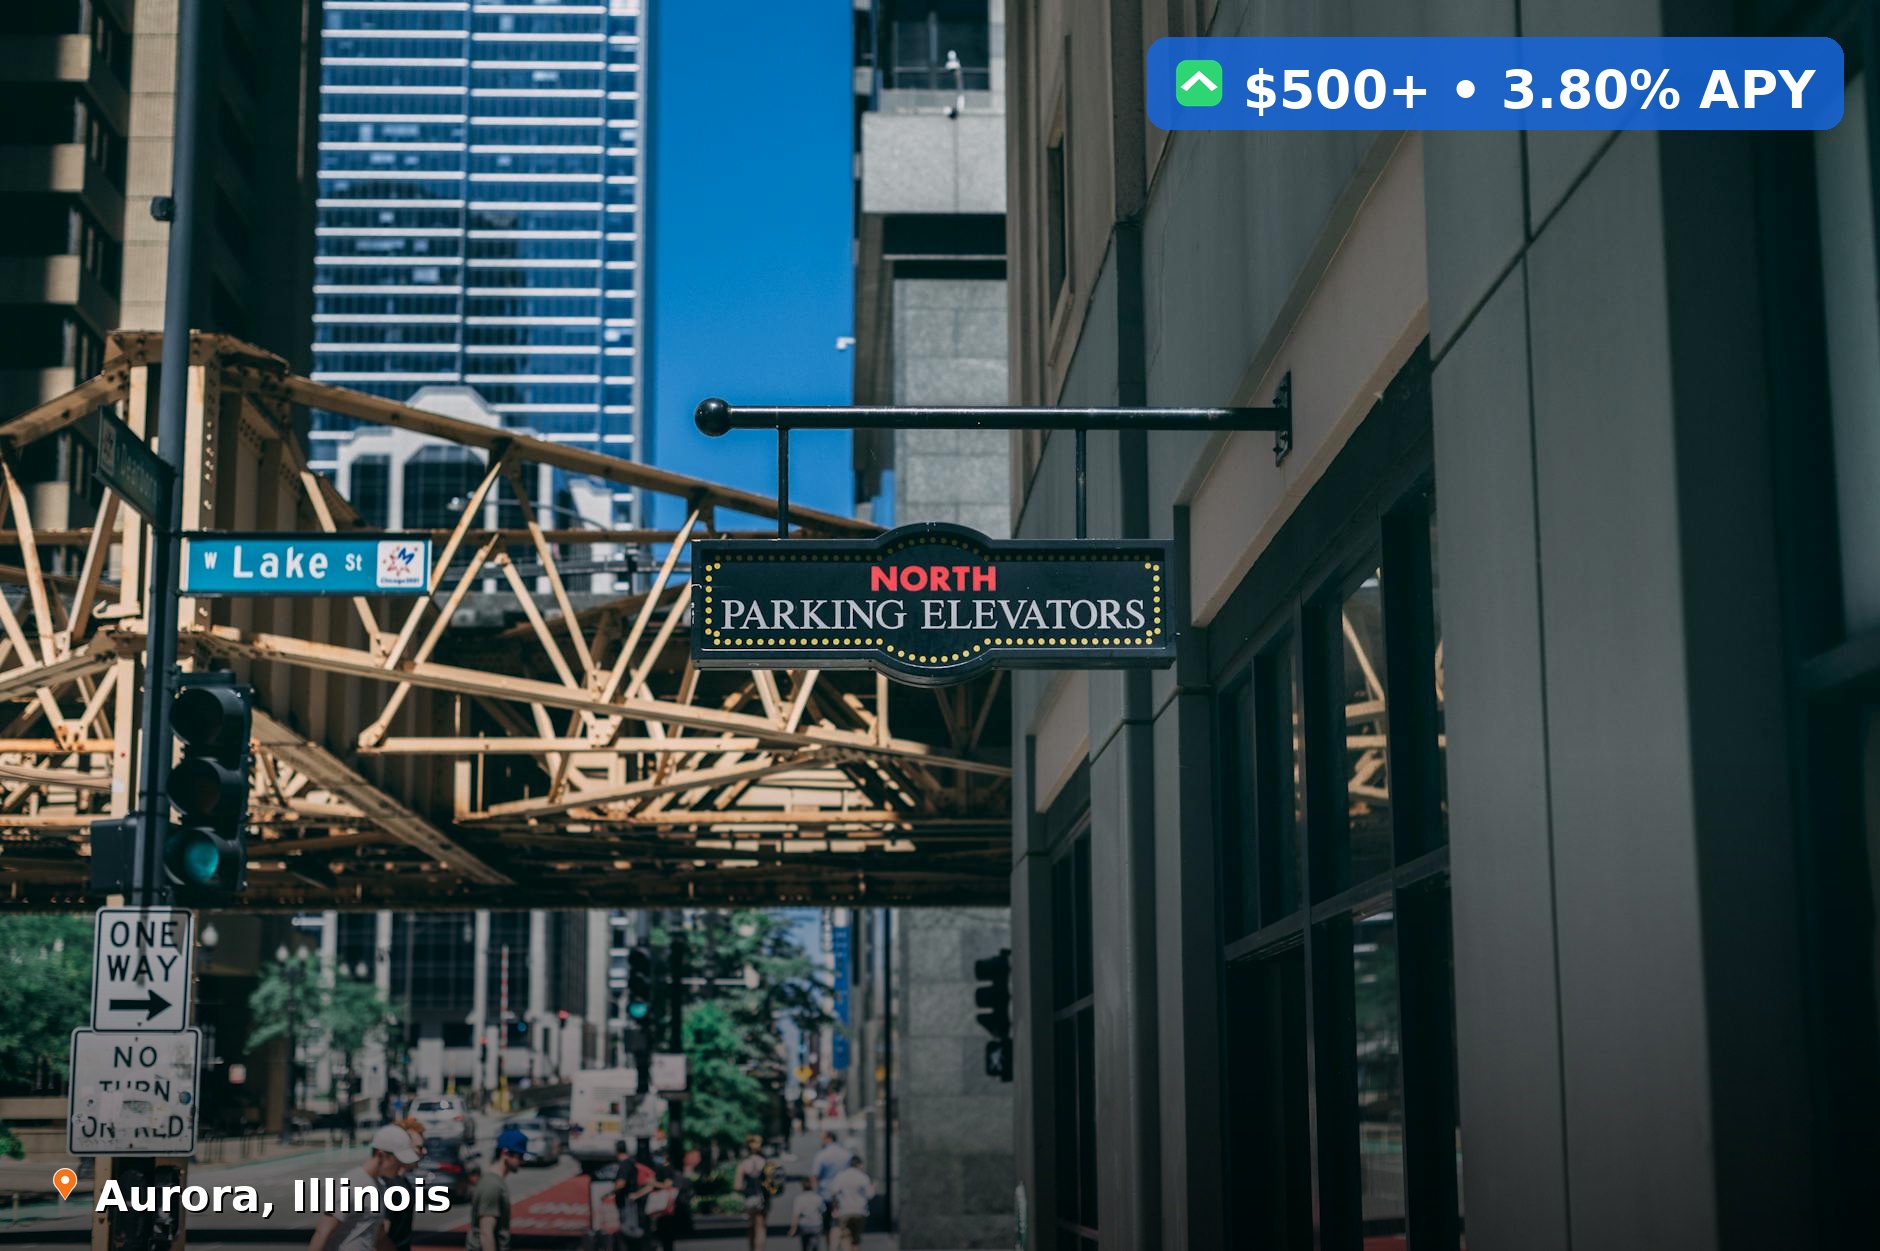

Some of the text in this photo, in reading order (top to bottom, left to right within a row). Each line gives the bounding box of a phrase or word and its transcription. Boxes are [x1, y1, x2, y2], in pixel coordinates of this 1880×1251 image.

[204, 545, 363, 579] W Lake St
[871, 565, 997, 592] NORTH
[720, 599, 1146, 630] PARKING ELEVATORS
[111, 921, 178, 948] ONE
[107, 954, 178, 982] WAY
[114, 1046, 157, 1068] NO
